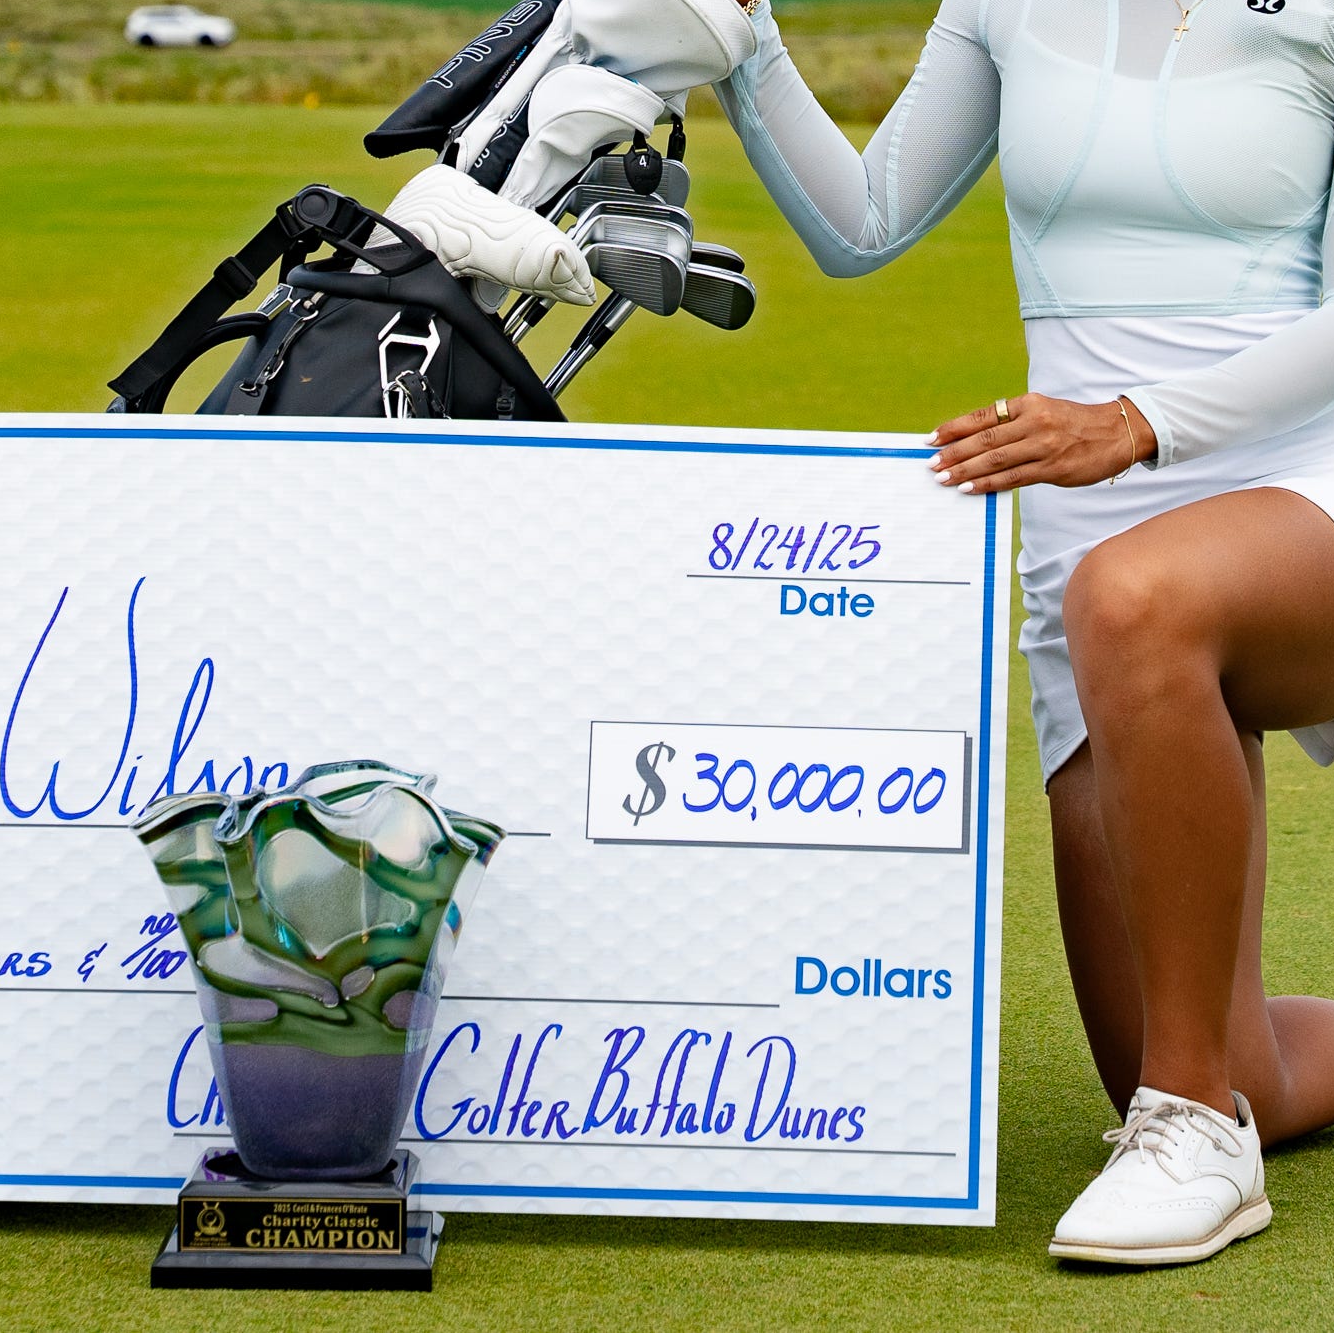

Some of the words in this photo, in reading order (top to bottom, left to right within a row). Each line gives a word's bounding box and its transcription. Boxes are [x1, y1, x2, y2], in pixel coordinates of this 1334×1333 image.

[426, 1, 542, 89] PING
[639, 155, 647, 167] 4
[709, 518, 881, 573] 8/24/25
[780, 585, 875, 618] Date
[0, 577, 289, 820] Wilson
[795, 956, 952, 1000] Dollars
[580, 1026, 736, 1139] Buffalo
[744, 1035, 867, 1143] Dunes
[245, 1228, 396, 1250] CHAMPION
[262, 1215, 321, 1229] Charity
[324, 1215, 379, 1228] Classic
